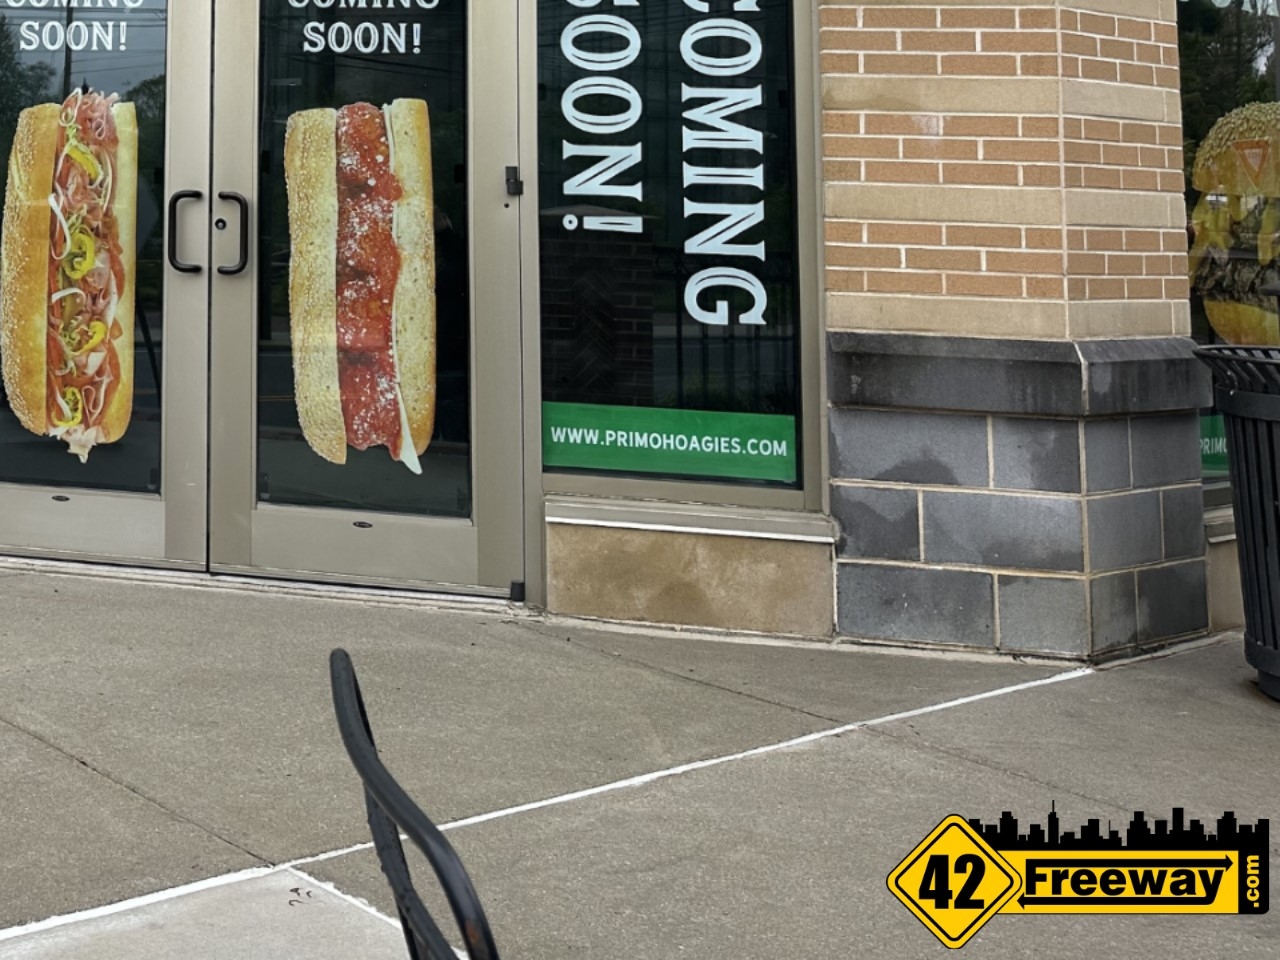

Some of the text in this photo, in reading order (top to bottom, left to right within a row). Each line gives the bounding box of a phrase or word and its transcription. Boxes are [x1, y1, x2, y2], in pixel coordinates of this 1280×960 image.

[20, 21, 128, 51] SOON!
[303, 21, 422, 54] SOON!
[550, 426, 787, 457] WWW.PRIMOHOAGIES.COM
